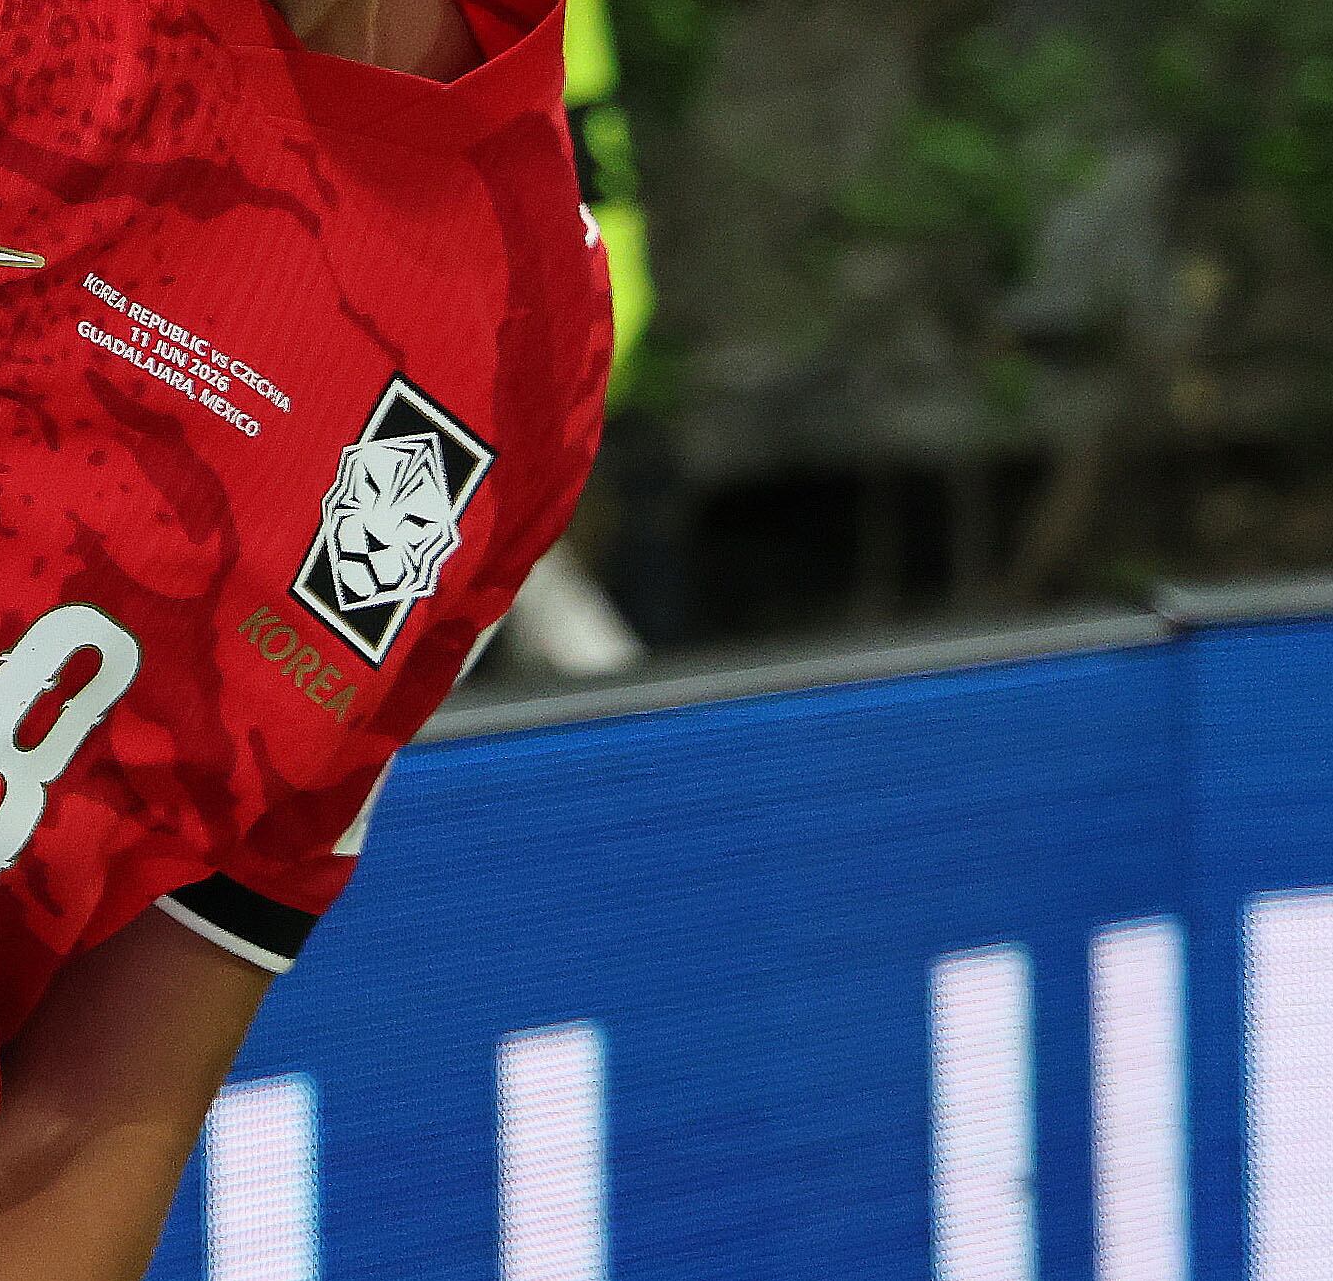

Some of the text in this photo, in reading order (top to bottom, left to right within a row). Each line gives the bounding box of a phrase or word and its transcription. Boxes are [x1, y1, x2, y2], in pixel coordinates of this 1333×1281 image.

[77, 321, 262, 437] GUADALAJARA, MEXICO
[82, 272, 128, 313] KOREA
[127, 302, 211, 357] REPUBLIC
[230, 360, 291, 413] CZECHIA
[130, 325, 232, 393] 11 JUN 2026
[237, 605, 358, 724] KOREA
